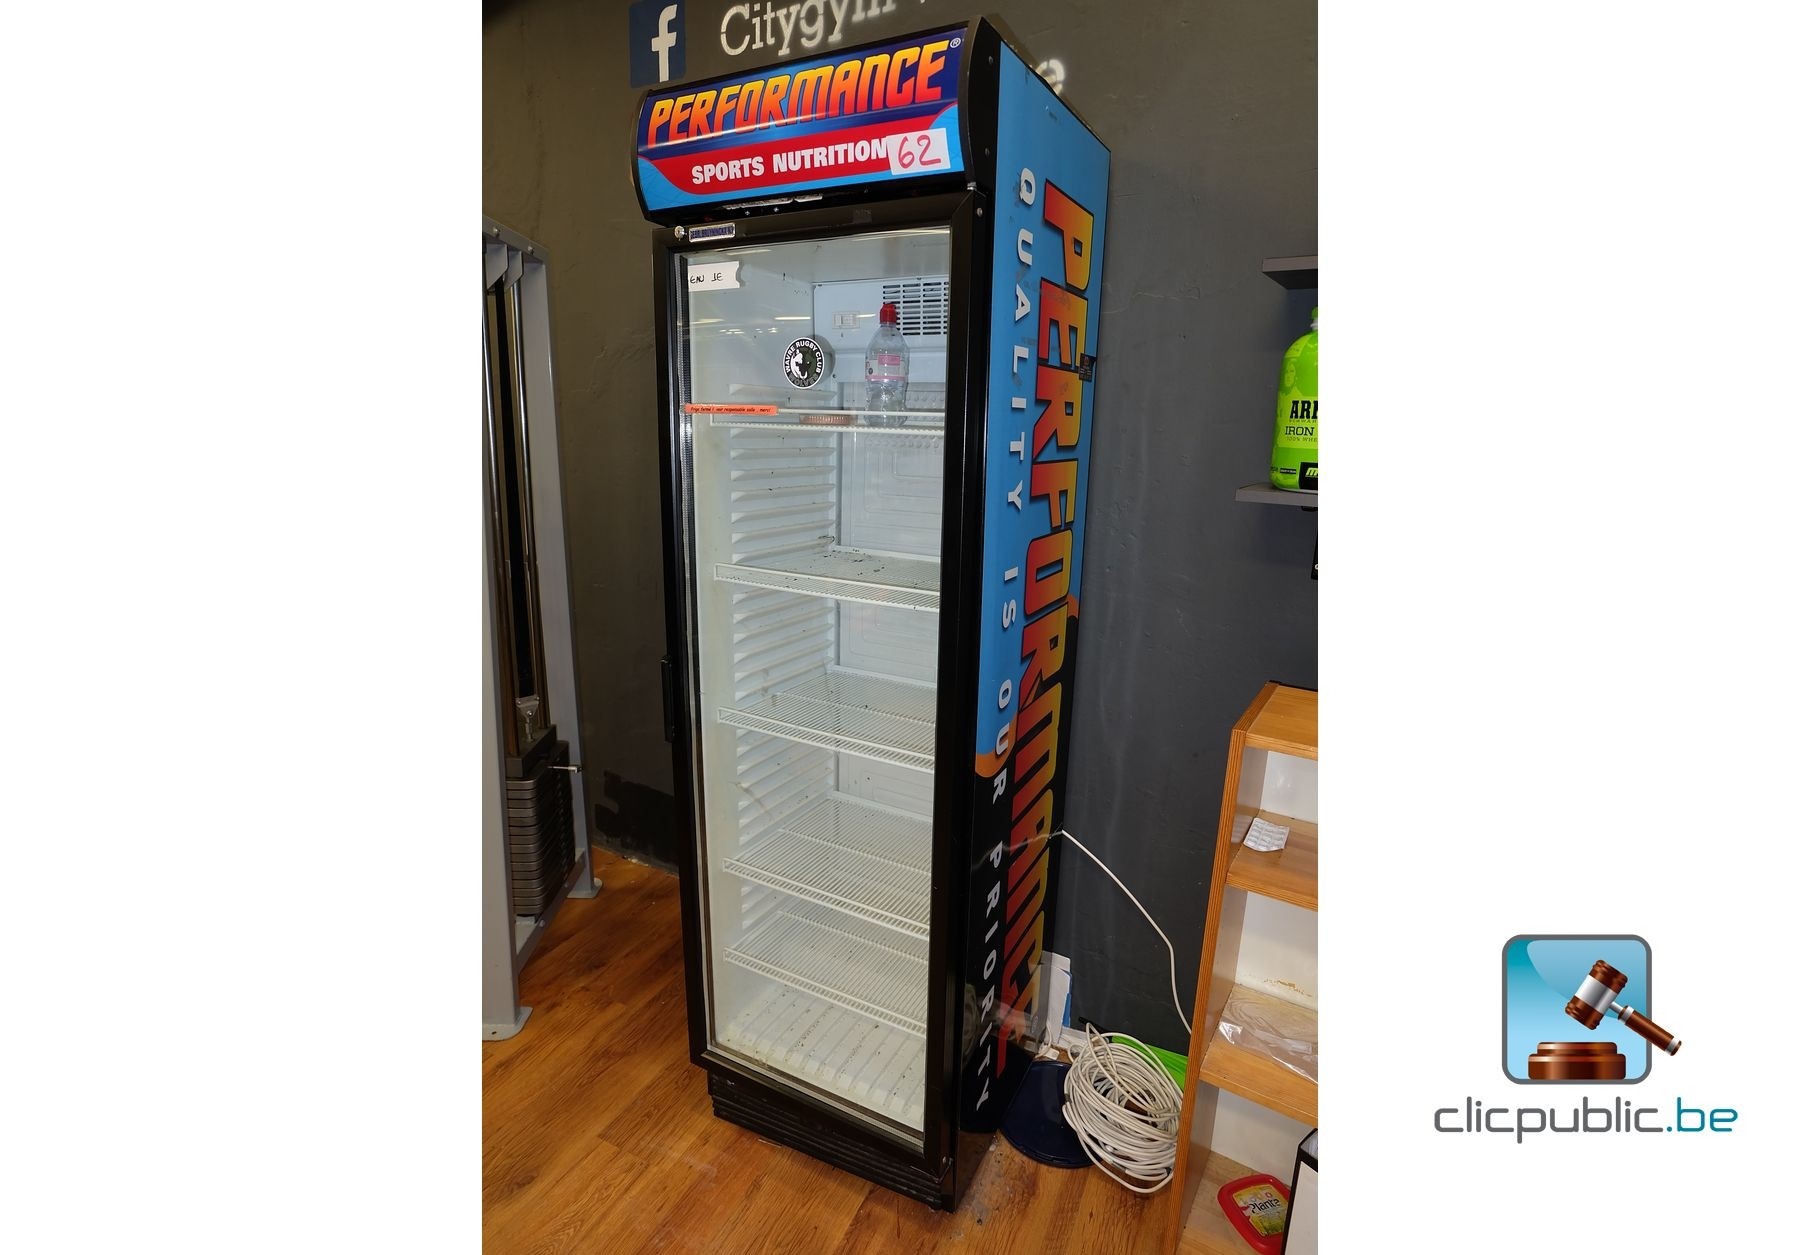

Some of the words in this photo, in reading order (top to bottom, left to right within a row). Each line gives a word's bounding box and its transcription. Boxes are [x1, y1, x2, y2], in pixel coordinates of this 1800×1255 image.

[691, 156, 765, 185] SPORTS
[772, 137, 888, 174] NUTRITION
[898, 134, 942, 169] 62
[785, 346, 795, 372] WAVRE
[795, 341, 818, 351] RUGBY
[815, 352, 823, 373] CLUB
[1007, 167, 1036, 511] QUALITY
[1285, 426, 1315, 436] IRON
[997, 178, 1096, 1080] PERFORMANCE
[1001, 566, 1019, 630] IS
[992, 679, 1012, 806] OUR
[976, 840, 1003, 1112] PRIORITY
